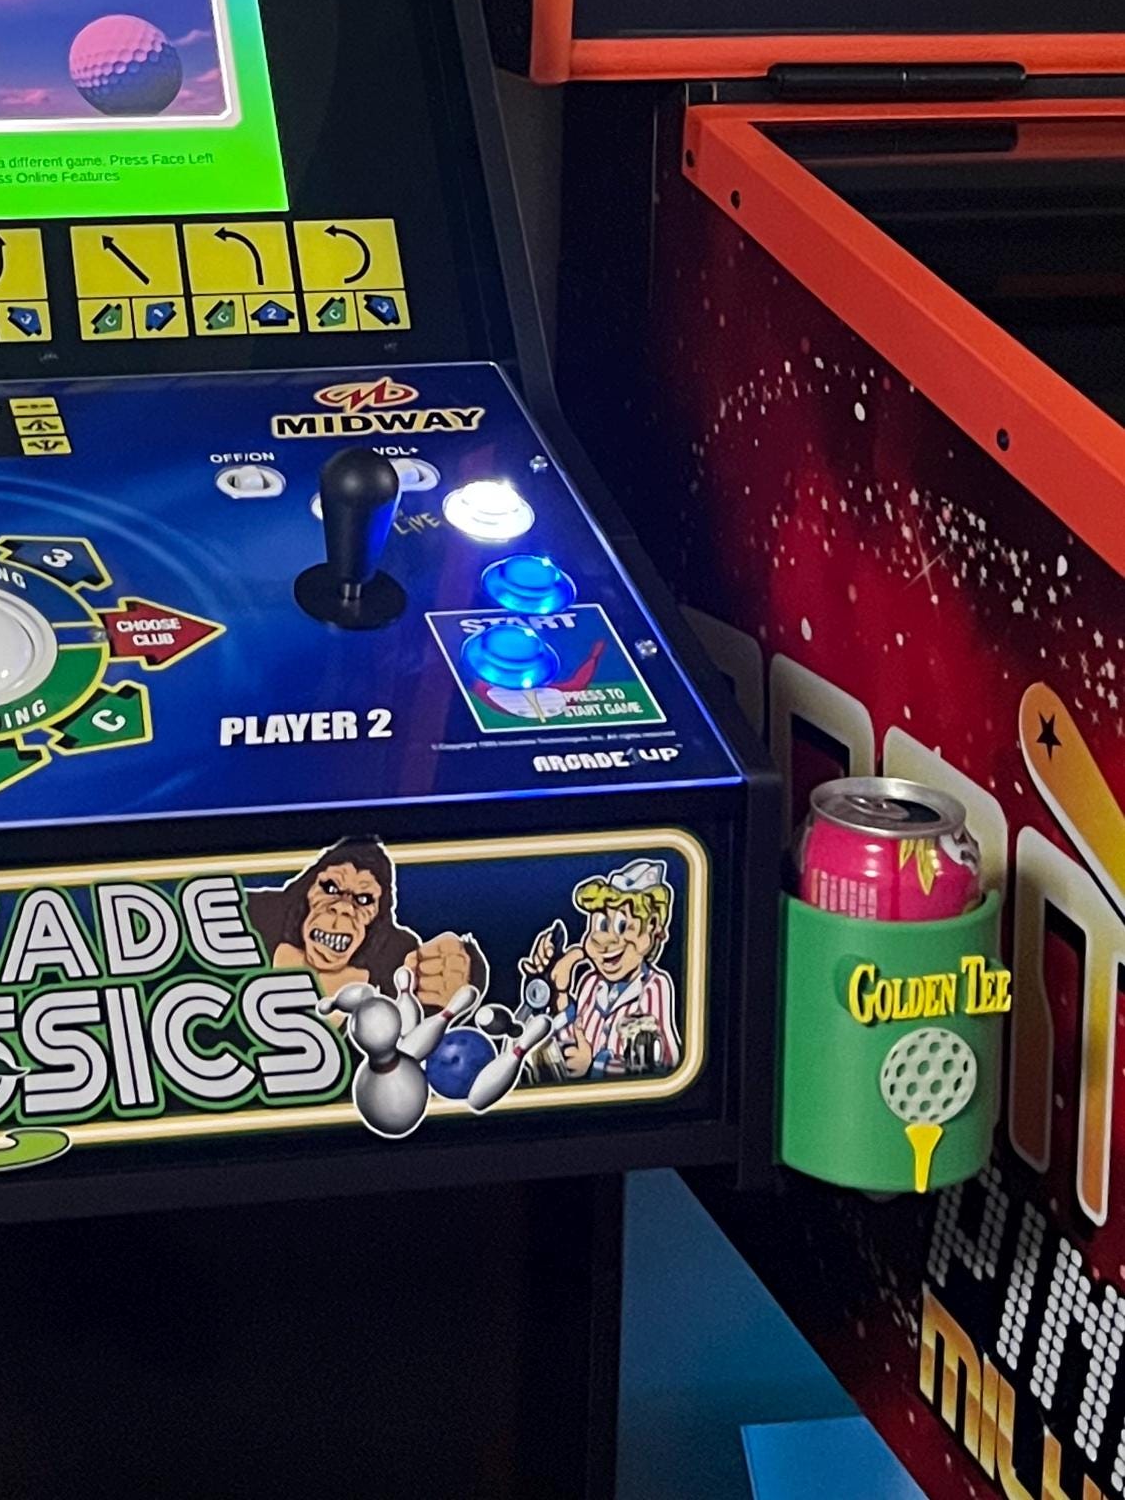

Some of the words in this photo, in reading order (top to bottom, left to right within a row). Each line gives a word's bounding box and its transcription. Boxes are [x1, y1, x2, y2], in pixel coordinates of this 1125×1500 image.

[109, 155, 148, 166] Press
[152, 153, 184, 165] Face
[188, 152, 213, 164] Left
[16, 172, 57, 184] Online
[275, 409, 482, 436] MIDWAY
[210, 452, 275, 464] OFF/ON
[41, 547, 74, 569] 3
[115, 617, 182, 632] CHOOSE
[131, 631, 175, 646] CLUB
[607, 688, 625, 701] TO
[92, 708, 126, 733] C
[220, 711, 358, 746] PLAYER
[367, 708, 393, 739] 2
